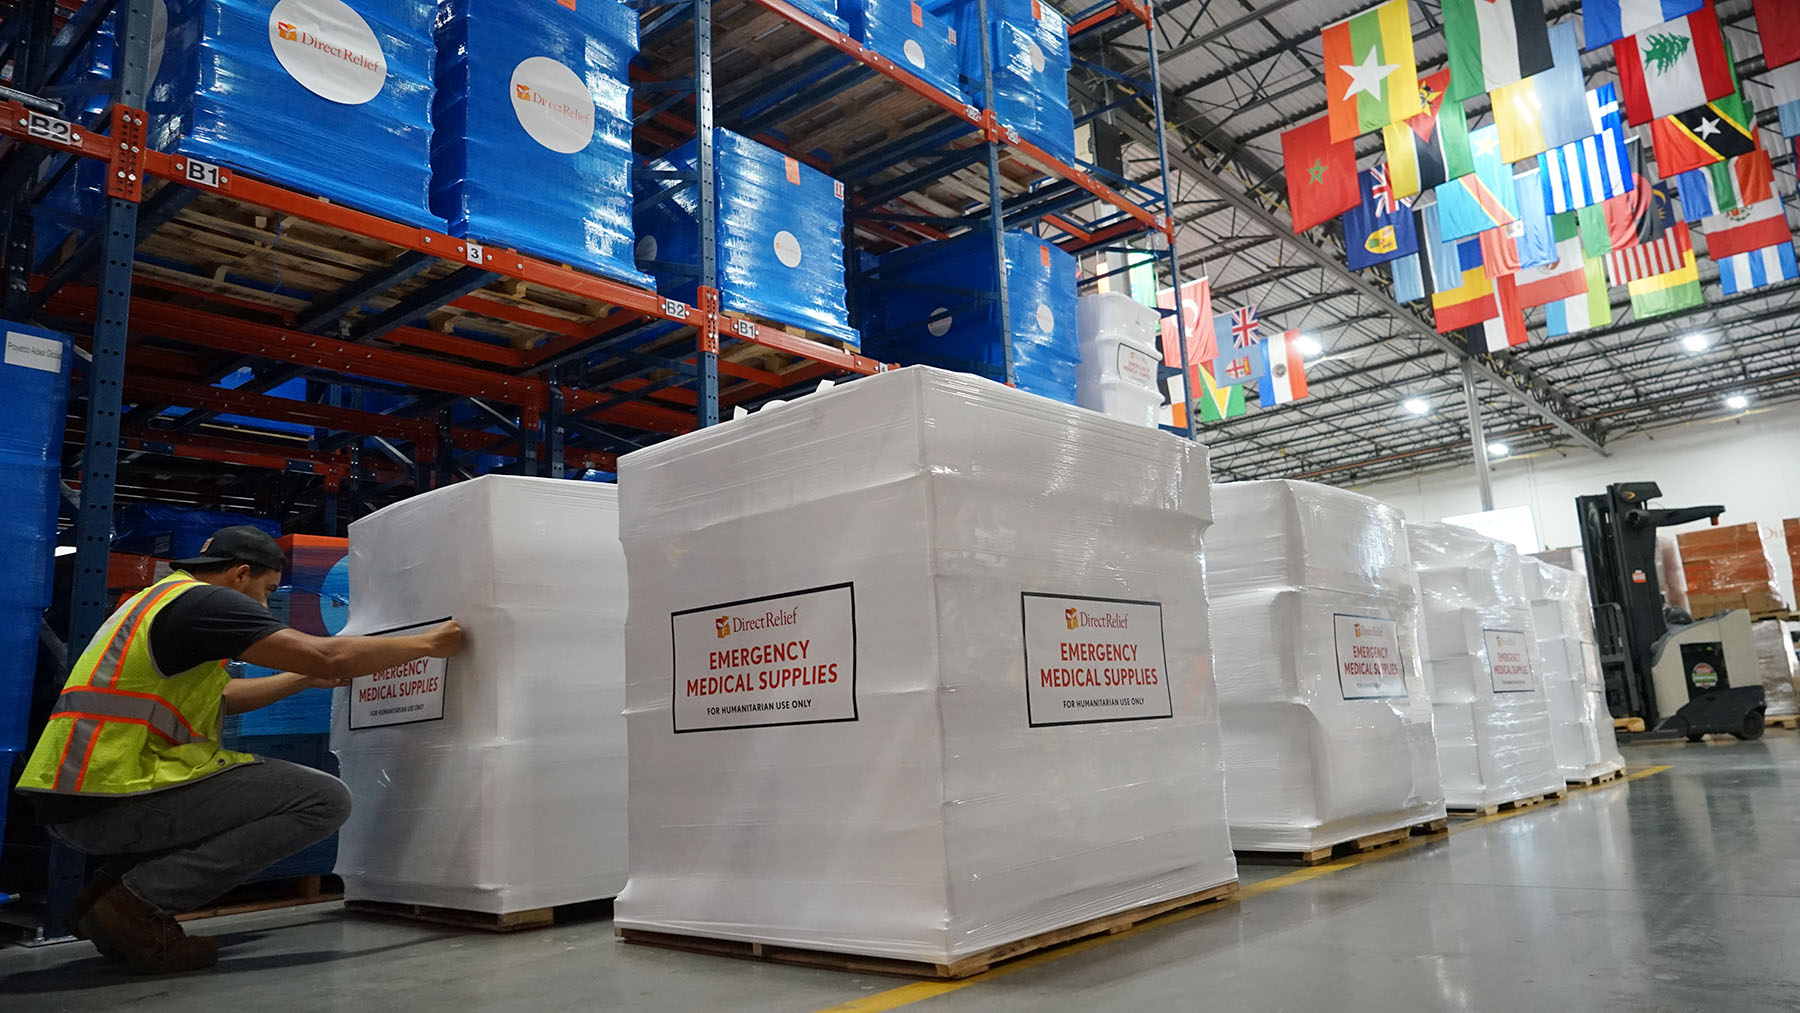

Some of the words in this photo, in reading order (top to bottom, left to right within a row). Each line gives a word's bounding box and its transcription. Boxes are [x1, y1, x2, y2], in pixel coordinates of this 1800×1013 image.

[31, 117, 69, 142] B2
[189, 161, 217, 185] B1
[470, 248, 479, 258] 3
[667, 301, 684, 317] B2
[740, 322, 754, 336] B1
[709, 639, 810, 670] EMERGENCY
[1060, 642, 1138, 662] EMERGENCY
[1353, 646, 1389, 659] EMERGENCY
[1344, 662, 1373, 675] MEDICAL
[686, 673, 754, 697] MEDICAL
[759, 663, 838, 691] SUPPLIES
[1041, 668, 1101, 688] MEDICAL
[1104, 668, 1159, 687] SUPPLIES
[359, 685, 397, 703] MEDICAL
[399, 677, 439, 697] SUPPLIES
[707, 707, 720, 716] FOR
[721, 702, 774, 715] HUMANITARIAN
[775, 701, 790, 711] USE
[792, 699, 812, 709] ONLY
[1063, 700, 1076, 709] FOR
[1076, 698, 1120, 708] HUMANITARIAN
[1120, 698, 1131, 706] USE
[1131, 697, 1145, 706] ONLY
